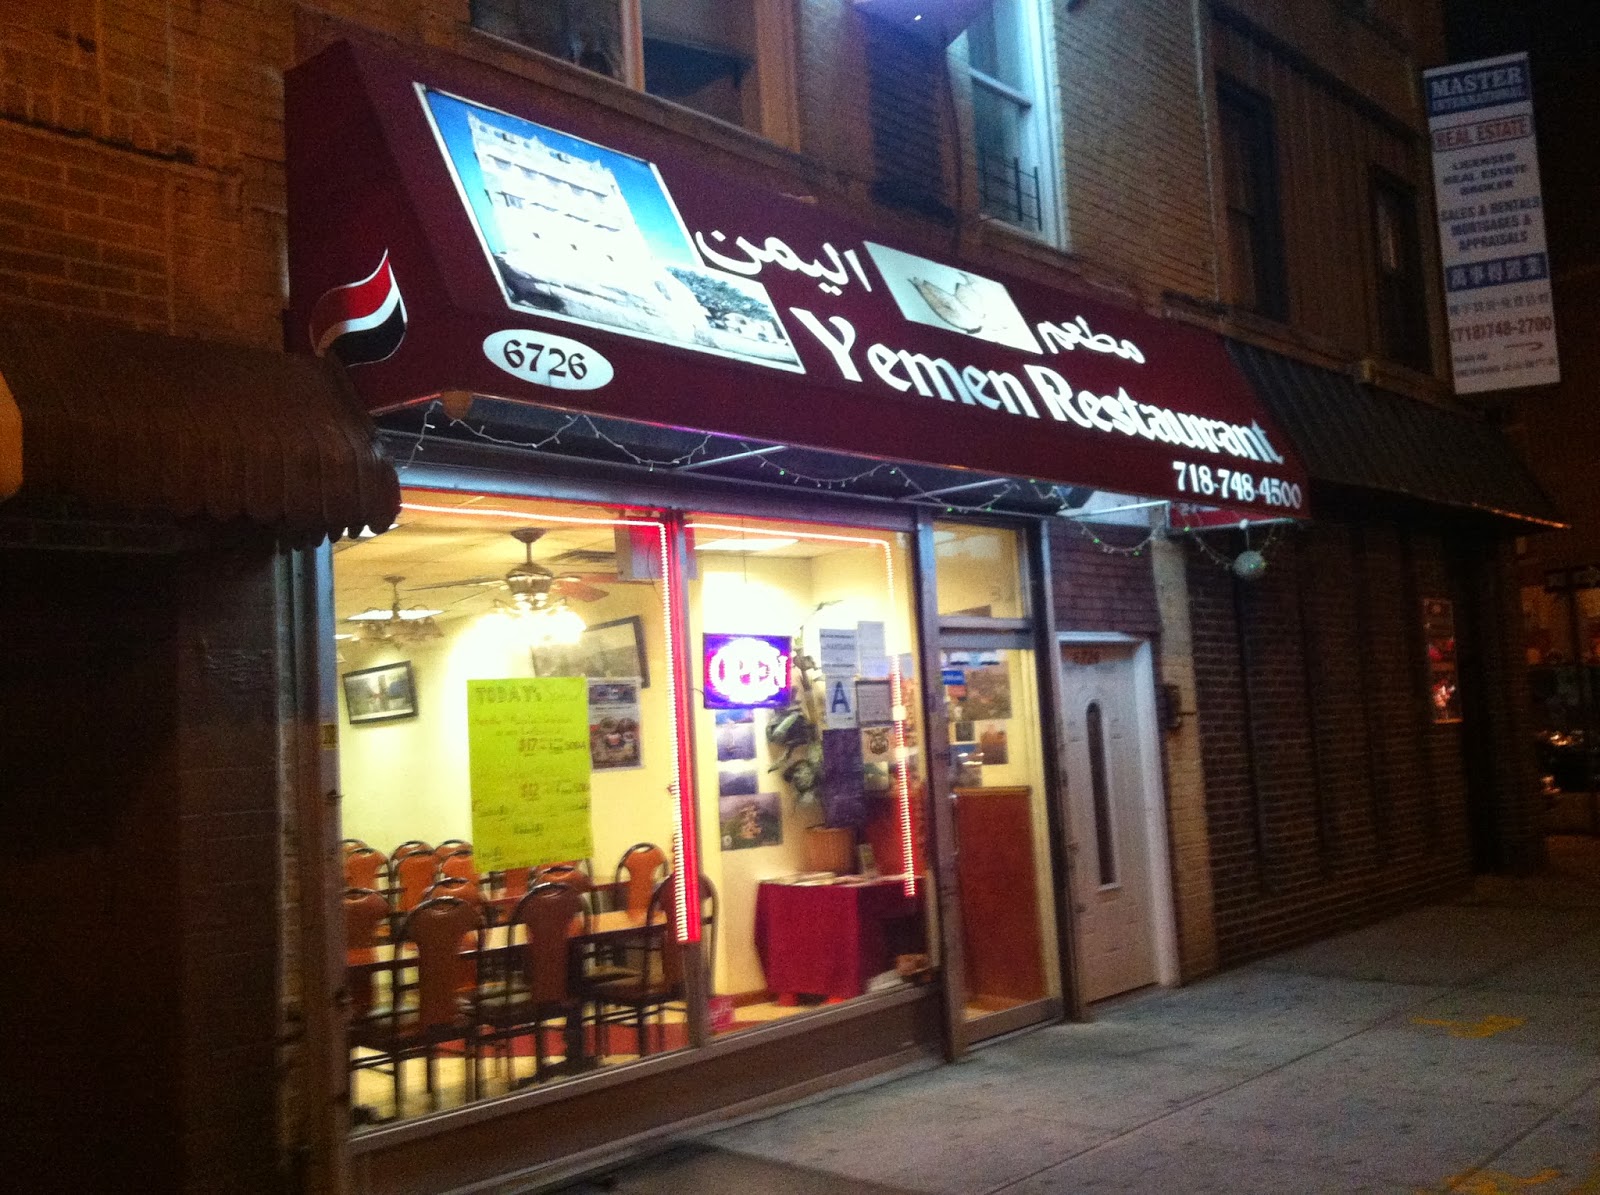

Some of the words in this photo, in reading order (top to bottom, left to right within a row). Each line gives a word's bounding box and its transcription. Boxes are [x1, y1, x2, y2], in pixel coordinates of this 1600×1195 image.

[1430, 66, 1524, 98] MASTER
[1435, 128, 1474, 148] REAL
[1477, 118, 1528, 141] ESTATE
[1440, 206, 1475, 222] SALES
[1490, 196, 1540, 214] RENTALS
[1459, 231, 1528, 251] APPRAISALS
[695, 229, 872, 296] اليمن
[1037, 315, 1146, 364] مطعم
[503, 339, 588, 380] 6726
[789, 306, 1041, 420] Yemen
[1023, 364, 1285, 465] Restaurant
[1172, 460, 1302, 511] 718-748-4500
[708, 651, 789, 690] OPEN
[830, 680, 851, 714] A
